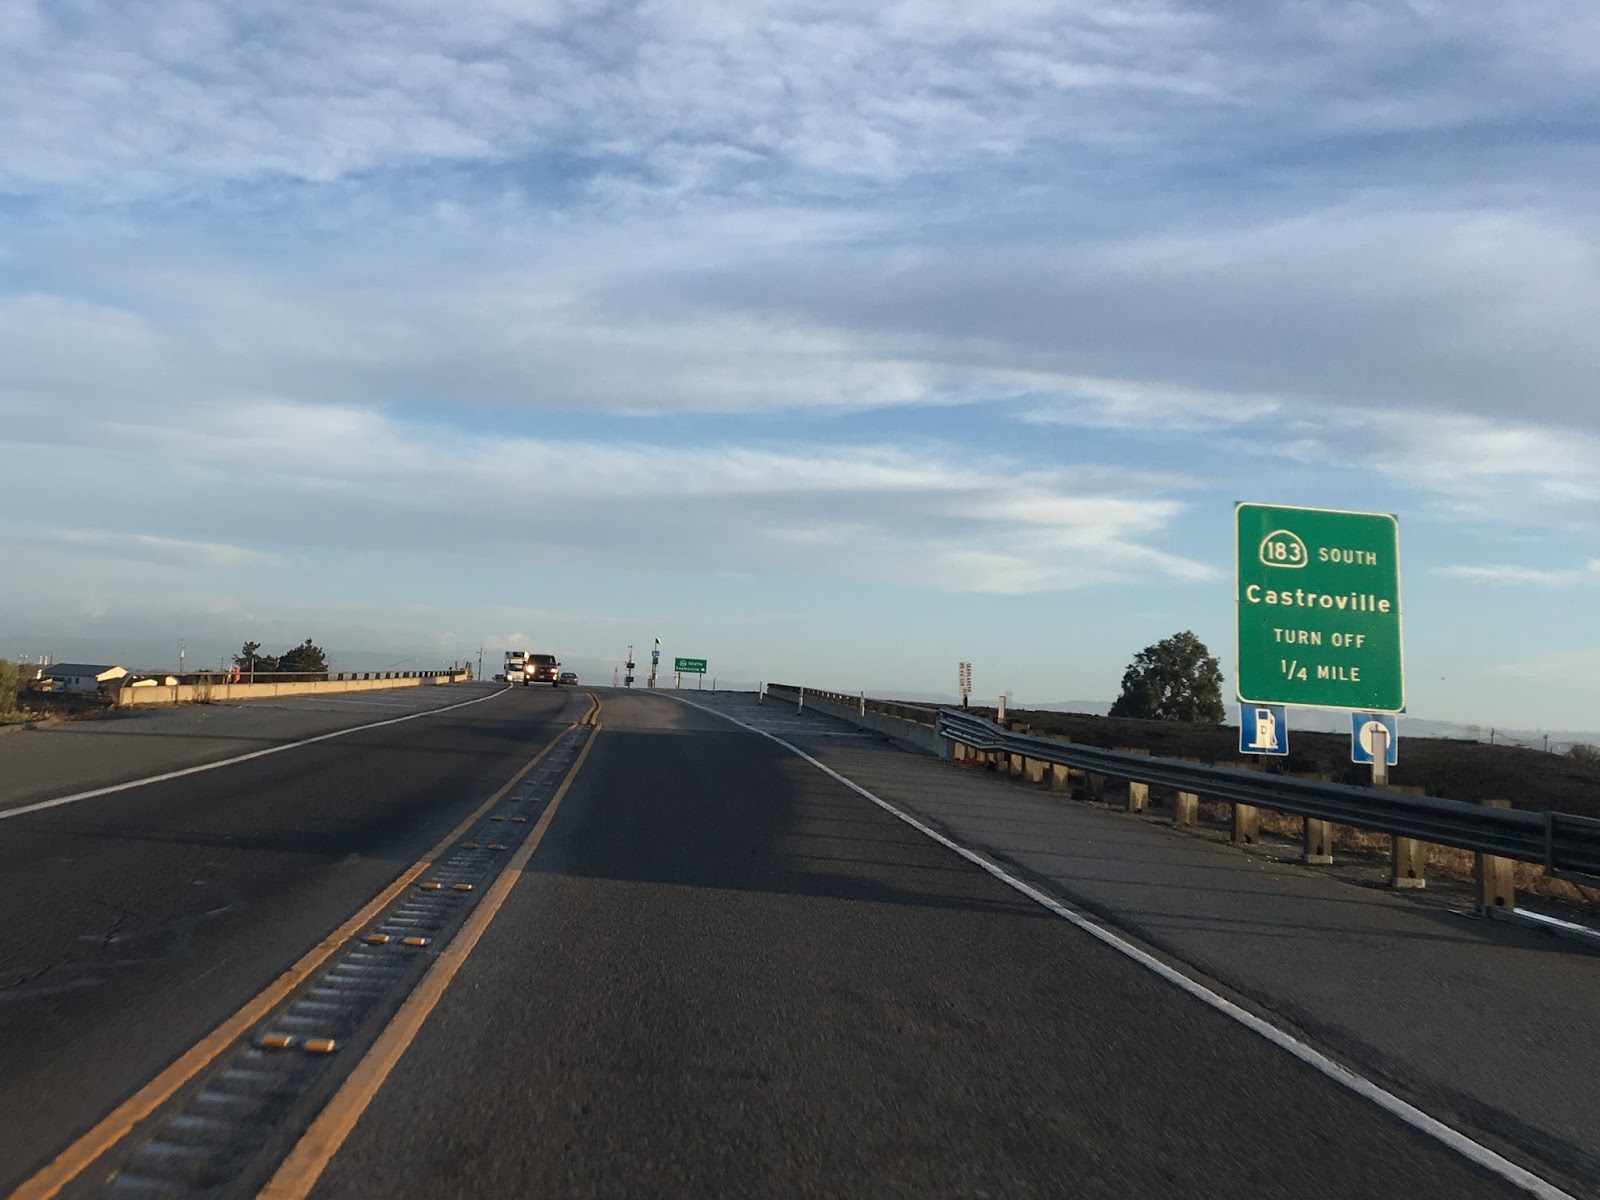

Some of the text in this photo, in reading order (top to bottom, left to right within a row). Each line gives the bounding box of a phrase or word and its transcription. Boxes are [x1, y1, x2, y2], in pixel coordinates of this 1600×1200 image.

[1267, 541, 1377, 566] 183 SOUTH
[1246, 584, 1391, 613] Castroville
[1274, 628, 1366, 649] TURN OFF
[1281, 659, 1361, 682] 1/4 MILE
[1260, 724, 1268, 735] D
